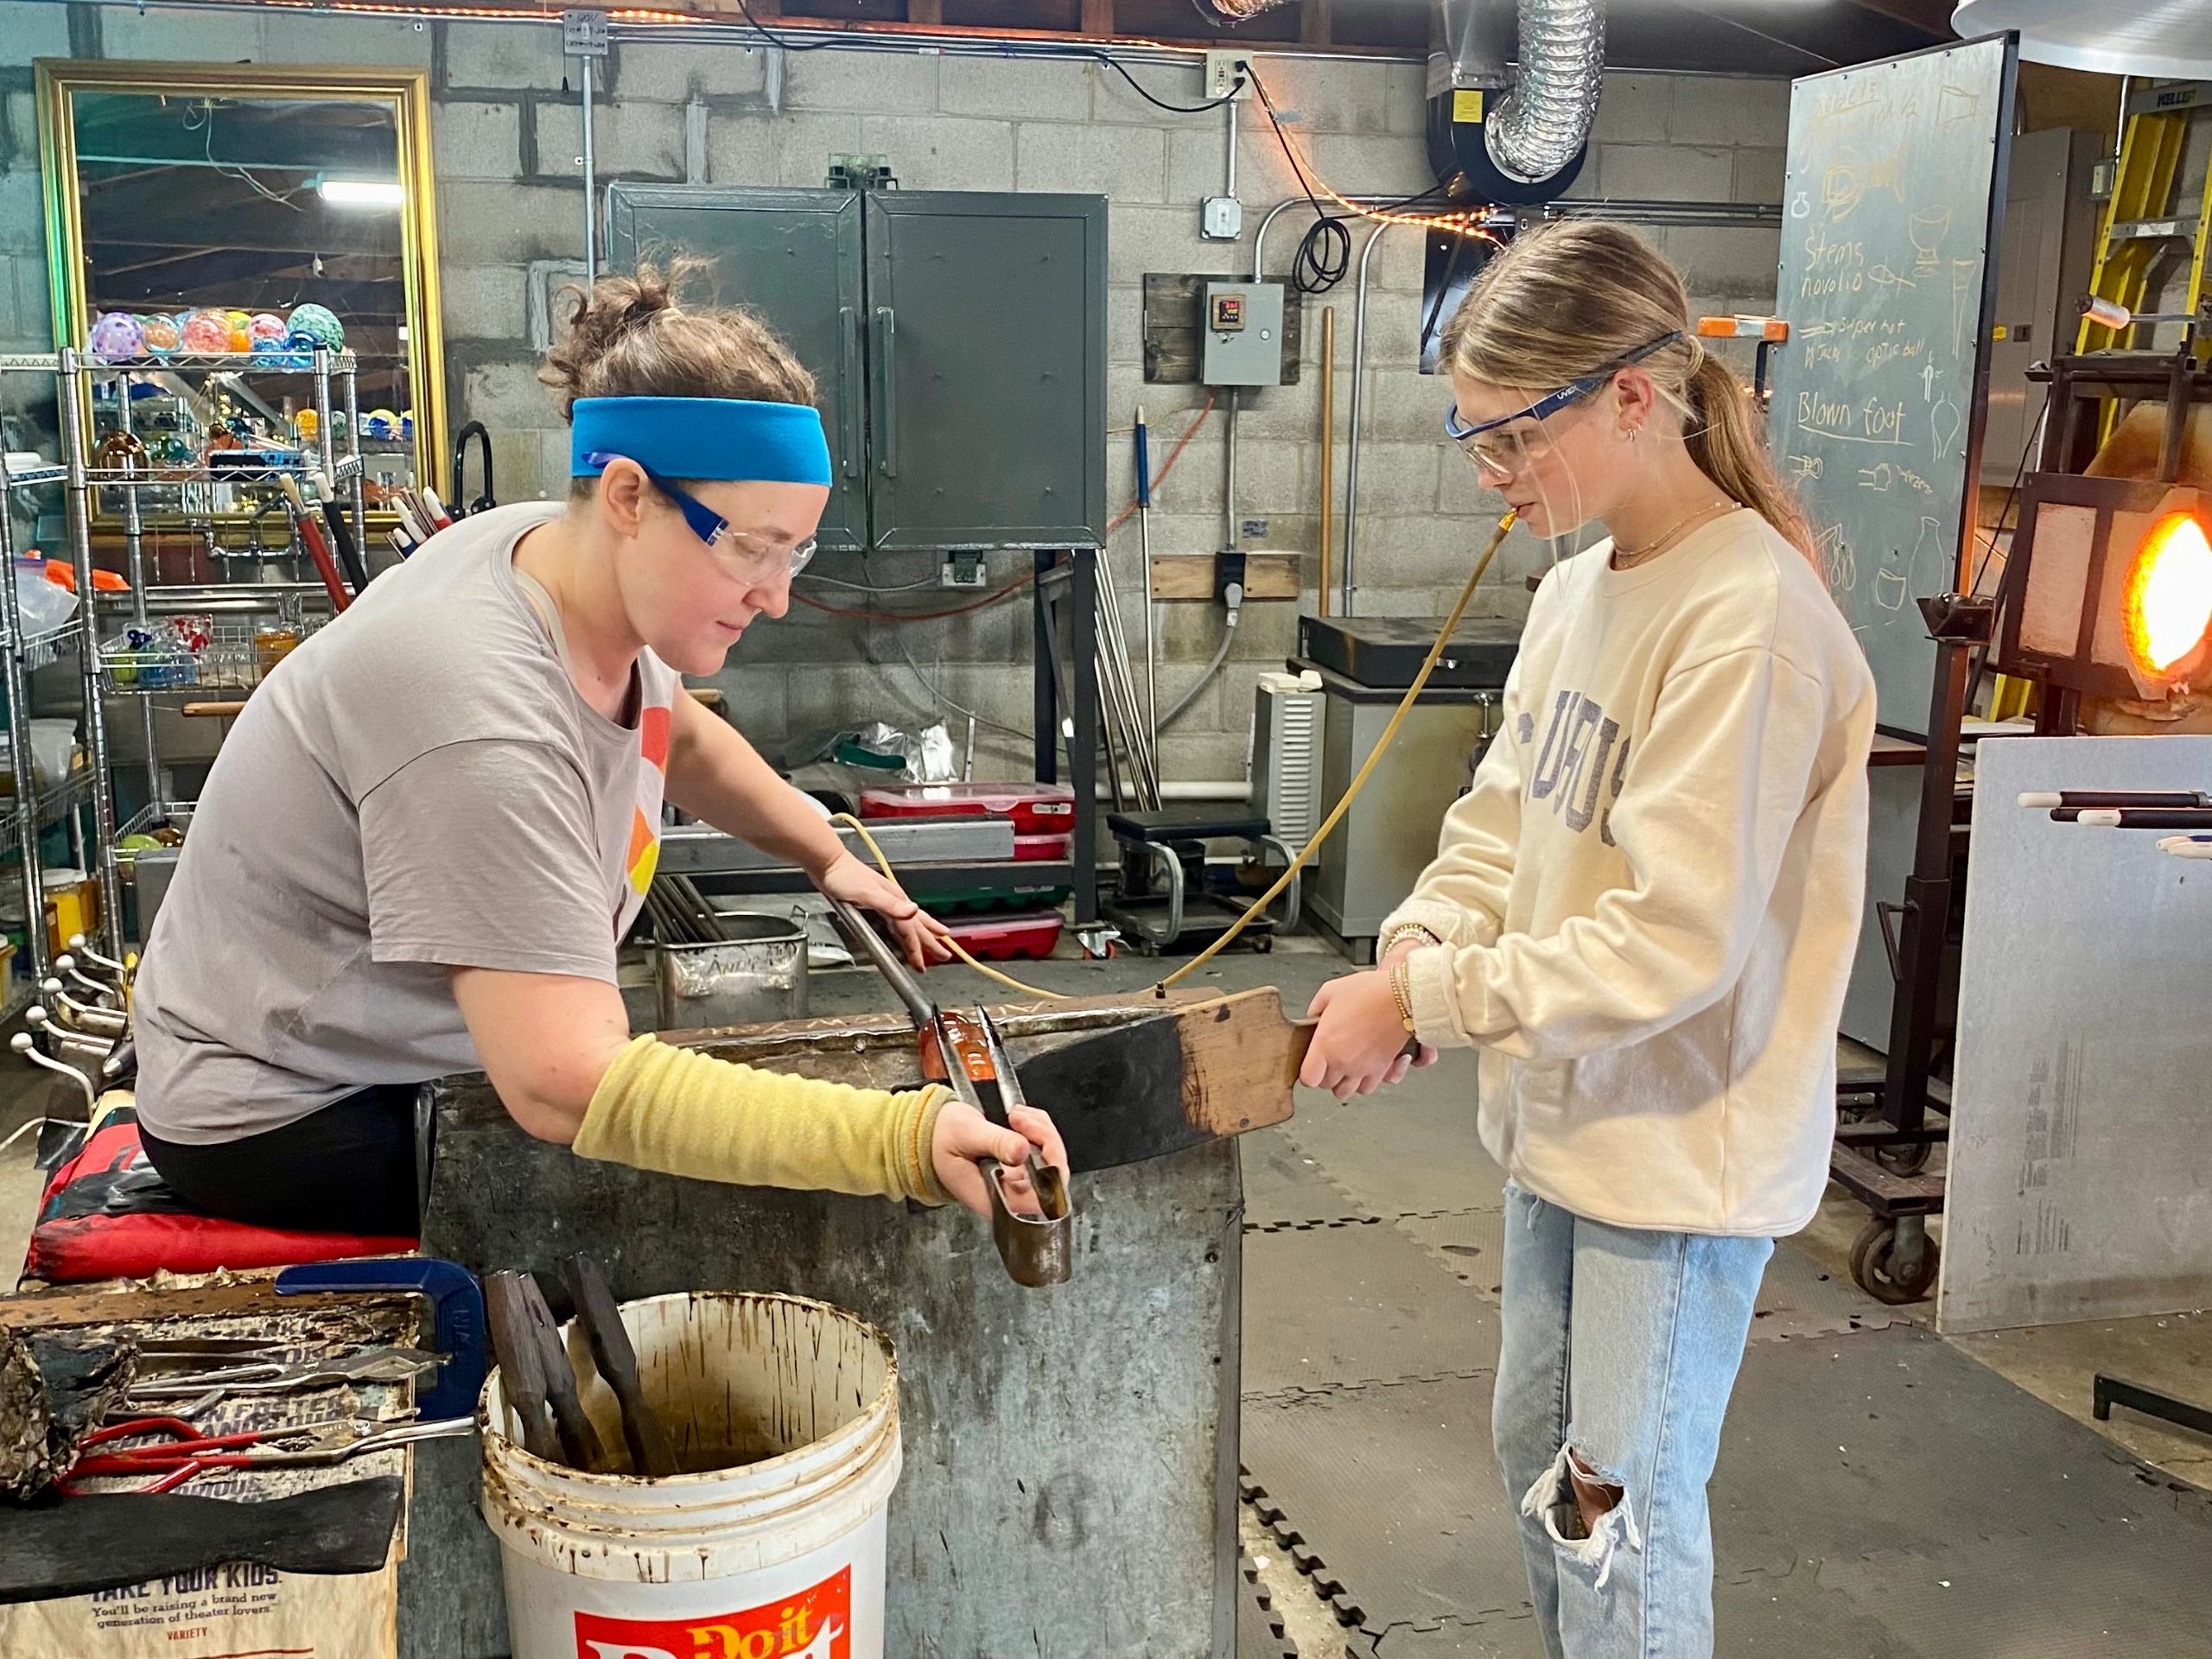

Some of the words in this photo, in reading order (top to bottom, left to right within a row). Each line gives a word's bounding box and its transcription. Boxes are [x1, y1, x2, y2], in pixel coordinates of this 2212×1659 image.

[1798, 391, 1851, 426] Blown
[162, 1566, 219, 1595] YOUR
[134, 1604, 149, 1614] be
[153, 1599, 197, 1613] raising
[213, 1593, 247, 1605] brand
[251, 1592, 277, 1602] new
[97, 1615, 165, 1629] generation
[168, 1611, 181, 1623] of
[185, 1608, 229, 1620] theater
[166, 1626, 208, 1641] VARIETY
